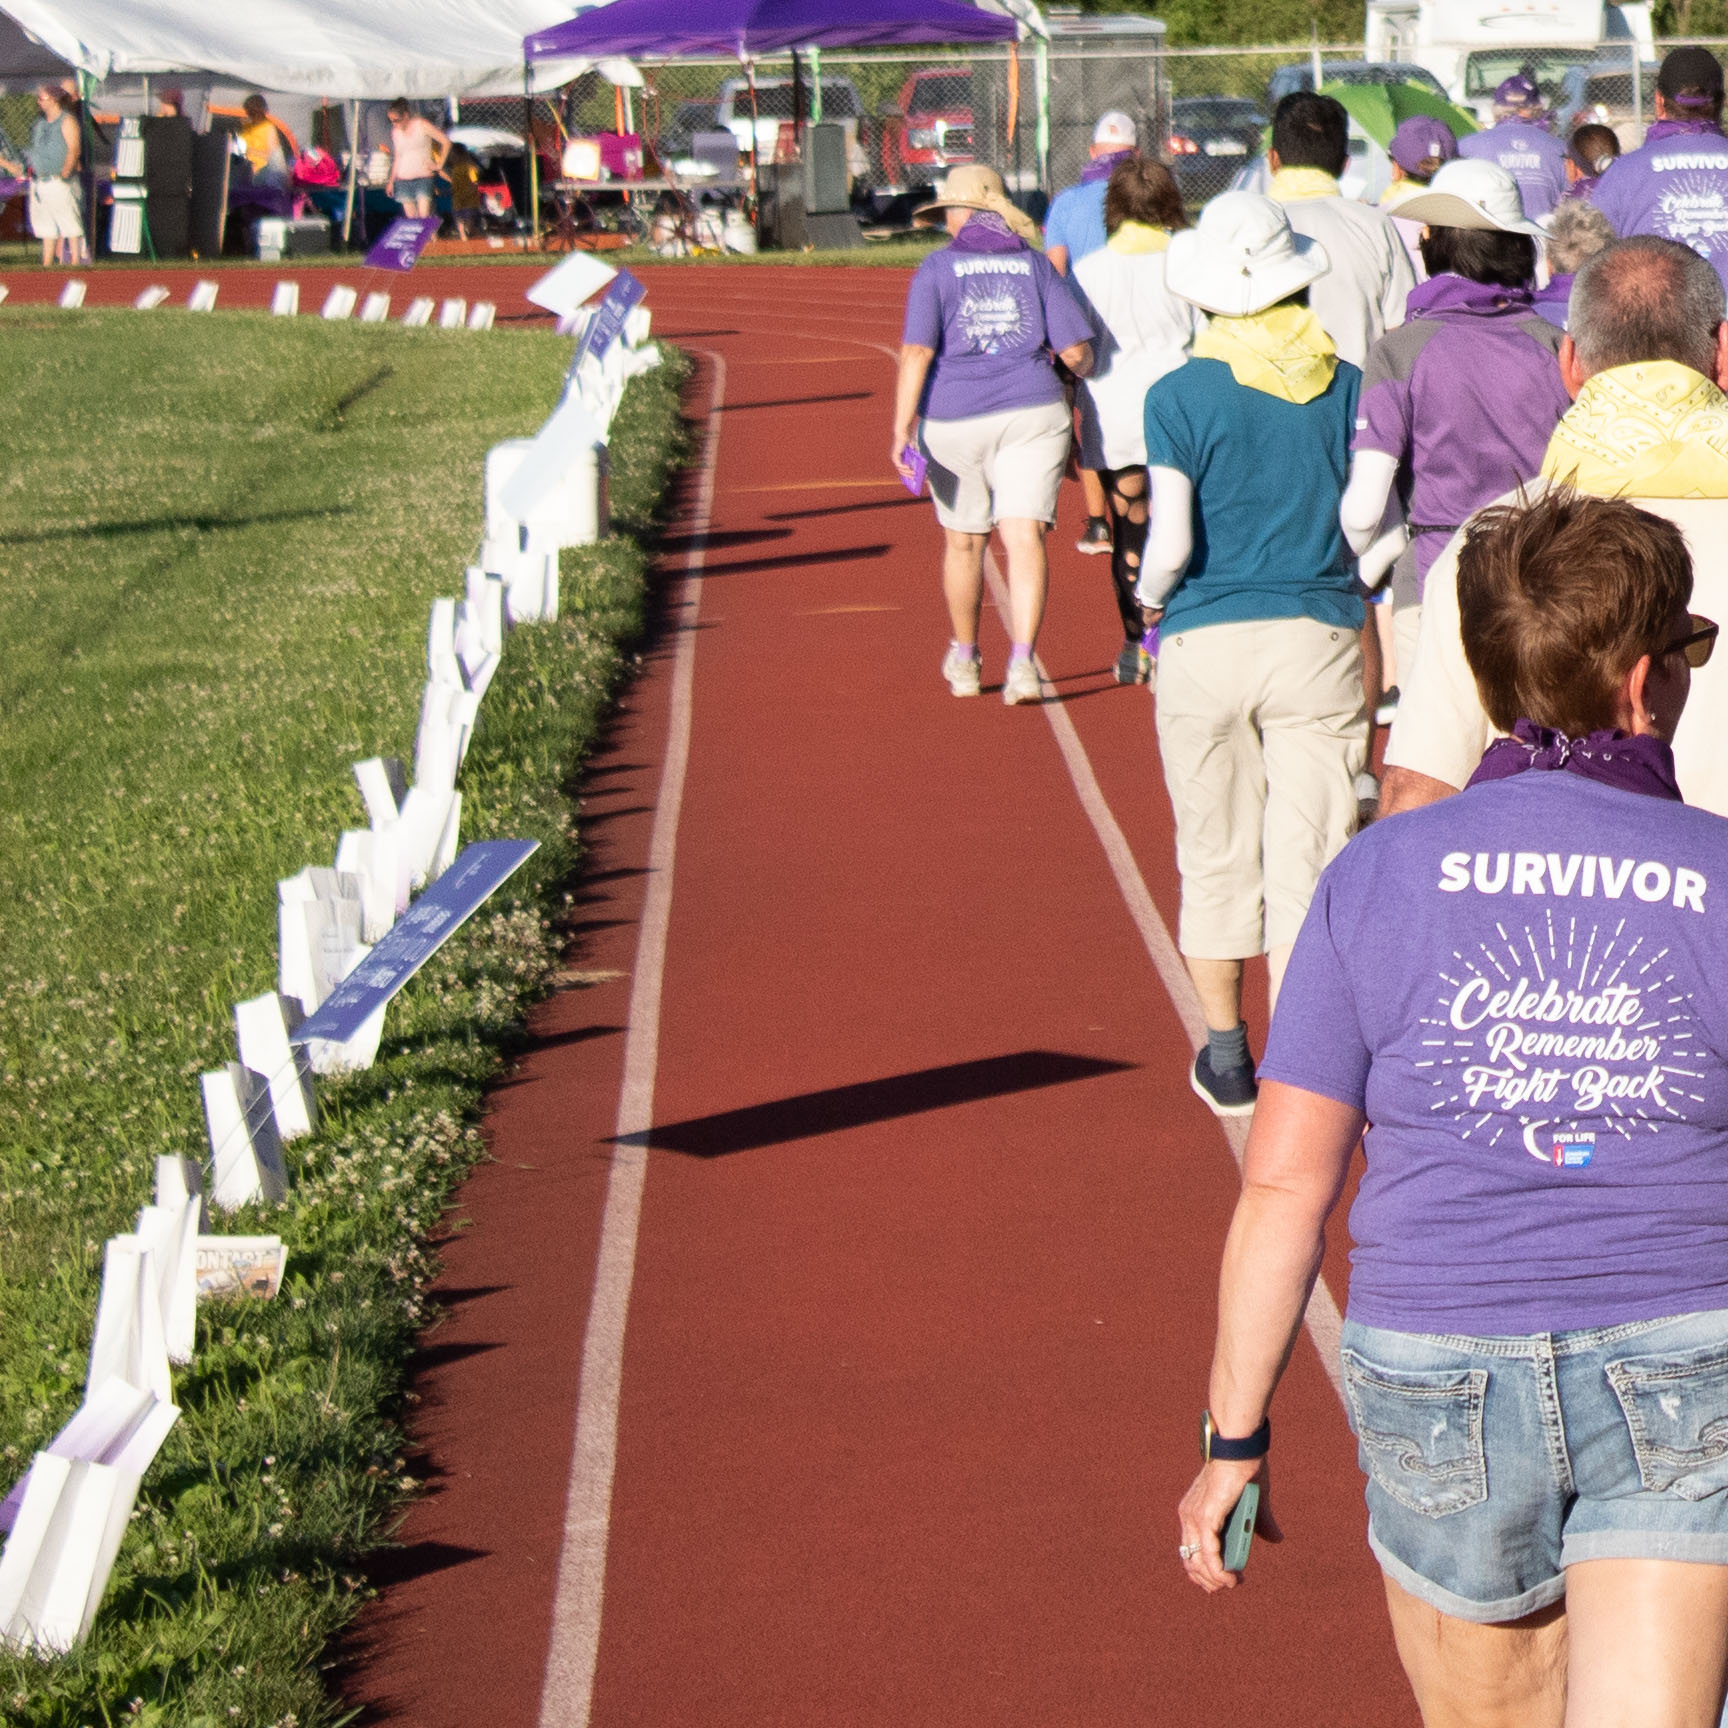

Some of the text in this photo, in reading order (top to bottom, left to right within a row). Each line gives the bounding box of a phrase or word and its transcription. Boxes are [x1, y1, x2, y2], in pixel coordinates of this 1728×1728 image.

[1662, 192, 1725, 214] Celebrate
[953, 258, 1031, 278] SURVIVOR
[1437, 851, 1708, 914] SURVIVOR
[1449, 976, 1645, 1031] Celebrate
[1485, 1022, 1662, 1072] Remember
[1462, 1064, 1668, 1112] Fight Back
